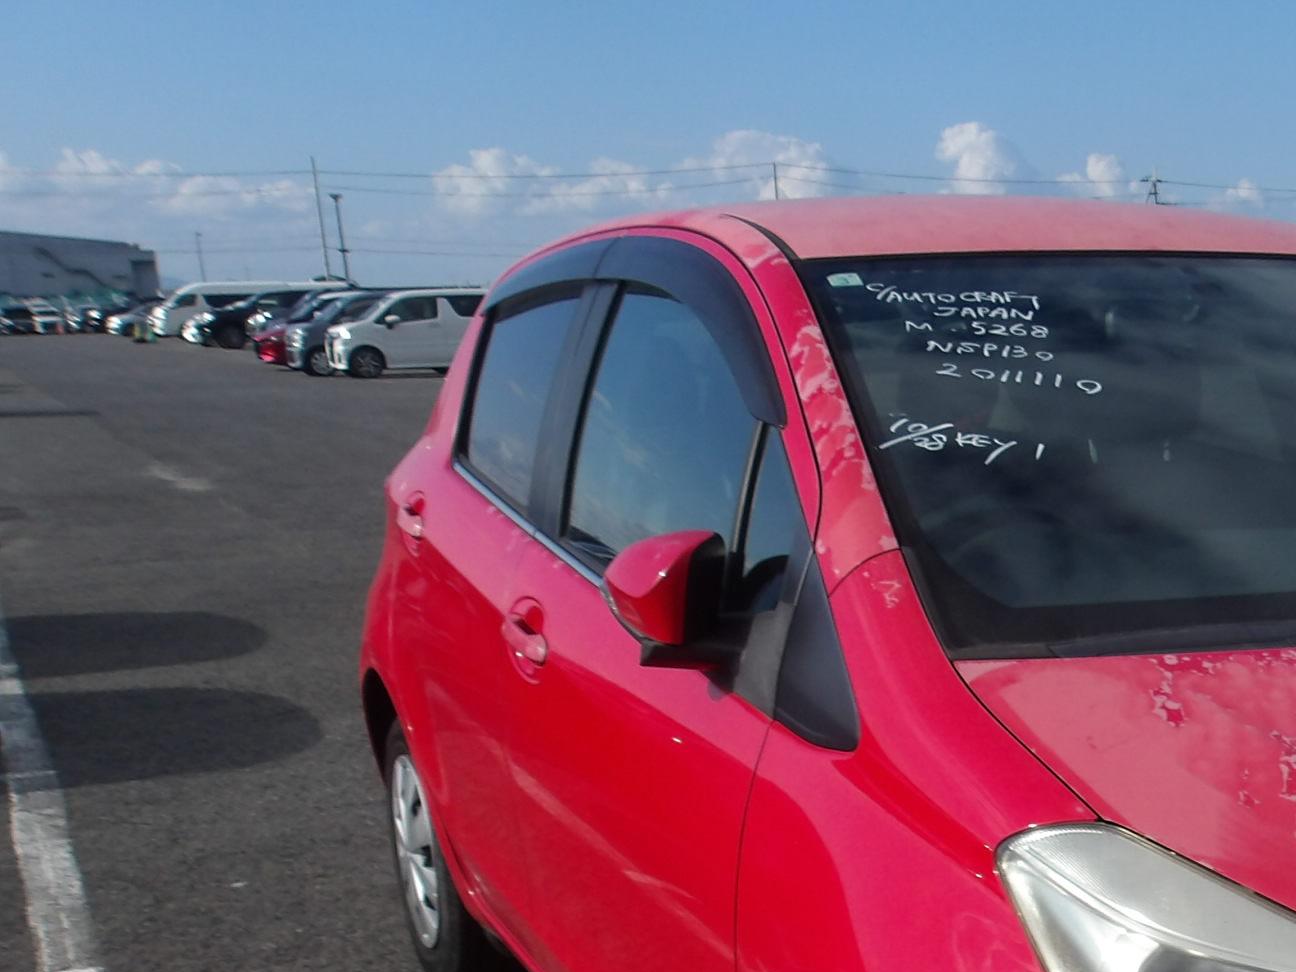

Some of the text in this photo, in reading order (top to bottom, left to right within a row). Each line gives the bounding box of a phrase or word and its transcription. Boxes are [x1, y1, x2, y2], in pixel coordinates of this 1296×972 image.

[933, 306, 1034, 321] JAPAN
[971, 321, 1049, 339] 5268
[955, 431, 1018, 465] KEY
